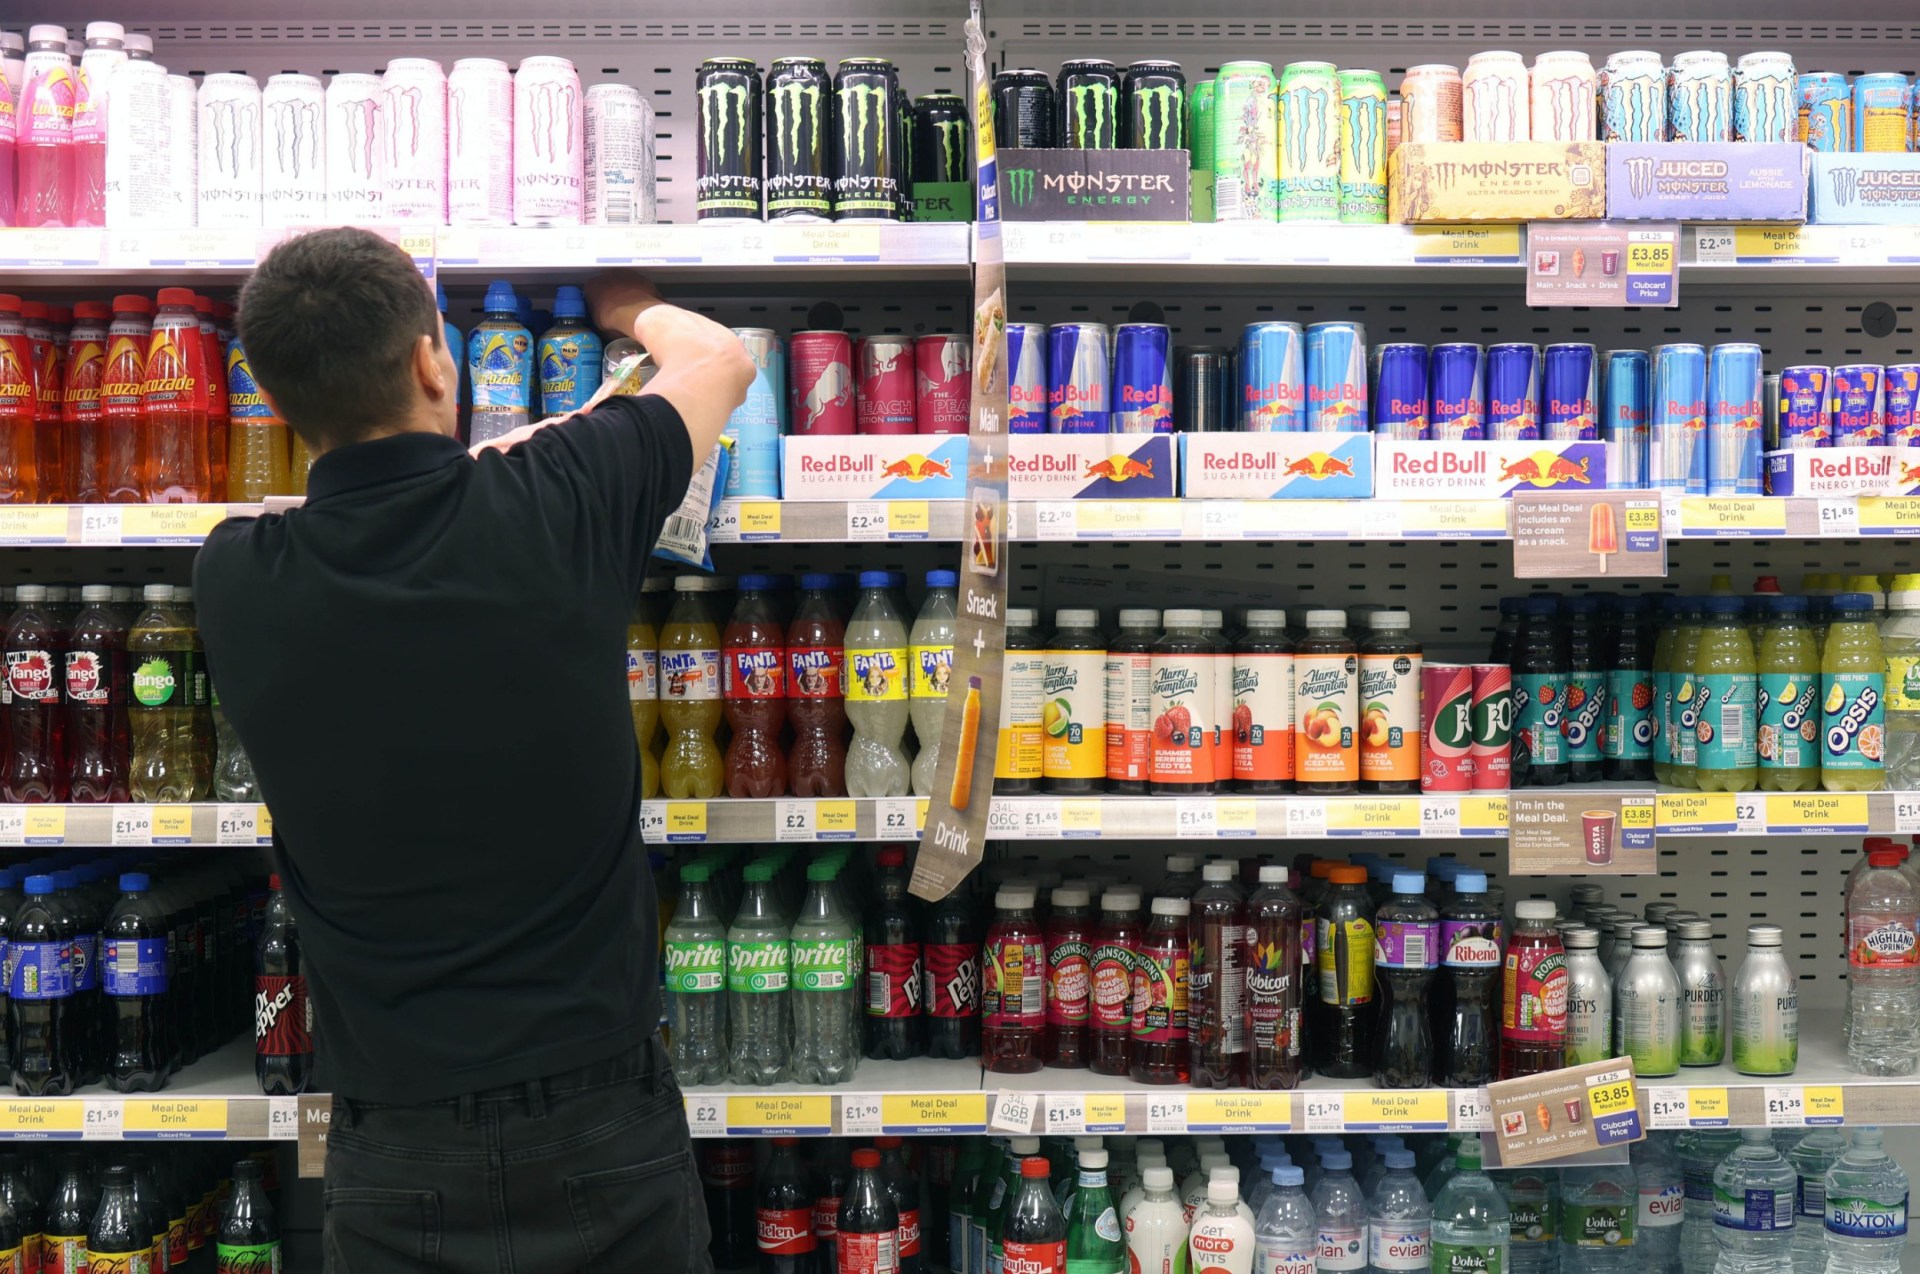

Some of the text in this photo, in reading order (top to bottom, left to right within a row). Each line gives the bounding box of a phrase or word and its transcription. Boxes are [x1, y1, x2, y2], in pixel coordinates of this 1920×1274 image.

[1461, 161, 1561, 177] MONSTER
[1656, 161, 1729, 177] JUICED
[1749, 169, 1783, 177] AUSSIE
[1044, 171, 1174, 193] MONSTER
[1657, 181, 1729, 193] MONSTER
[1740, 180, 1793, 189] LEMONADE
[981, 182, 996, 200] Clubcard
[1068, 196, 1151, 204] ENERGY
[985, 204, 994, 220] Price
[1442, 230, 1488, 238] Meal Deal
[1453, 241, 1479, 249] Drink
[1700, 238, 1732, 249] £2.05
[1632, 249, 1668, 261] £3.85
[1640, 289, 1658, 297] Price
[980, 407, 999, 432] Main
[801, 454, 874, 472] Red Bull
[1810, 457, 1851, 478] Red
[1856, 455, 1891, 476] Bull
[801, 475, 874, 483] SUGARFREE
[1811, 479, 1889, 490] ENERGY DRINK
[1518, 504, 1583, 513] Our Meal Deal
[1822, 508, 1854, 520] £1.85
[852, 517, 884, 528] £2.60
[1518, 515, 1557, 523] includes
[1628, 512, 1656, 521] £3.85
[1518, 526, 1536, 534] ice
[1518, 538, 1530, 546] as
[1539, 537, 1568, 546] snack.
[967, 588, 997, 619] Snack
[7, 652, 28, 664] WIN
[661, 654, 697, 669] FANTA
[792, 650, 830, 667] FANTA
[11, 666, 50, 682] Tango
[1155, 667, 1188, 681] Harry
[133, 672, 175, 689] Tango
[1152, 675, 1197, 693] Bromptons
[1783, 685, 1816, 729] Oasis
[1828, 687, 1877, 753] Oasis
[1191, 731, 1200, 739] 70
[994, 803, 1014, 812] 34L
[1516, 800, 1564, 810] I'm in the
[1661, 798, 1707, 808] Meal Deal
[1026, 812, 1058, 824] £1.65
[1423, 808, 1455, 820] £1.60
[1516, 813, 1568, 823] Meal Deal.
[1625, 810, 1651, 818] £3.85
[1672, 808, 1698, 818] Drink
[116, 820, 148, 833] £1.80
[786, 814, 804, 828] £2
[934, 821, 970, 856] Drink
[1867, 933, 1914, 949] HIGHLAND
[665, 944, 722, 968] Sprite
[729, 944, 788, 968] Sprite
[1455, 947, 1497, 961] Ribena
[1059, 965, 1081, 974] WIN
[1059, 974, 1082, 984] YOUR
[1247, 968, 1290, 988] Rubicon
[1057, 981, 1089, 992] SUMMER
[1059, 989, 1090, 1001] WHEELS
[1253, 994, 1279, 1005] Spring
[1684, 989, 1724, 1003] PURDEY'S
[1597, 1073, 1619, 1082] £4.25
[1512, 1091, 1540, 1103] breakfast
[1541, 1084, 1581, 1097] combination.
[1593, 1086, 1629, 1103] £3.85
[1372, 1097, 1418, 1106] Meal Deal
[1769, 1099, 1800, 1112] £1.35
[151, 1103, 198, 1113] Meal Deal
[697, 1107, 716, 1121] £2
[1308, 1103, 1340, 1116] £1.70
[1382, 1107, 1408, 1116] Drink
[1653, 1103, 1685, 1114] £1.90
[87, 1110, 118, 1123] £1.59
[161, 1114, 187, 1123] Drink
[1050, 1109, 1081, 1121] £1.55
[1601, 1118, 1633, 1131] Clubcard
[1610, 1128, 1628, 1137] Price
[1508, 1128, 1588, 1150] Main Snack Drink
[1586, 1217, 1617, 1228] Volvic
[1835, 1212, 1895, 1227] BUXTON
[758, 1221, 794, 1239] Helen
[1389, 1243, 1426, 1257] evian
[1452, 1255, 1485, 1268] Volvic
